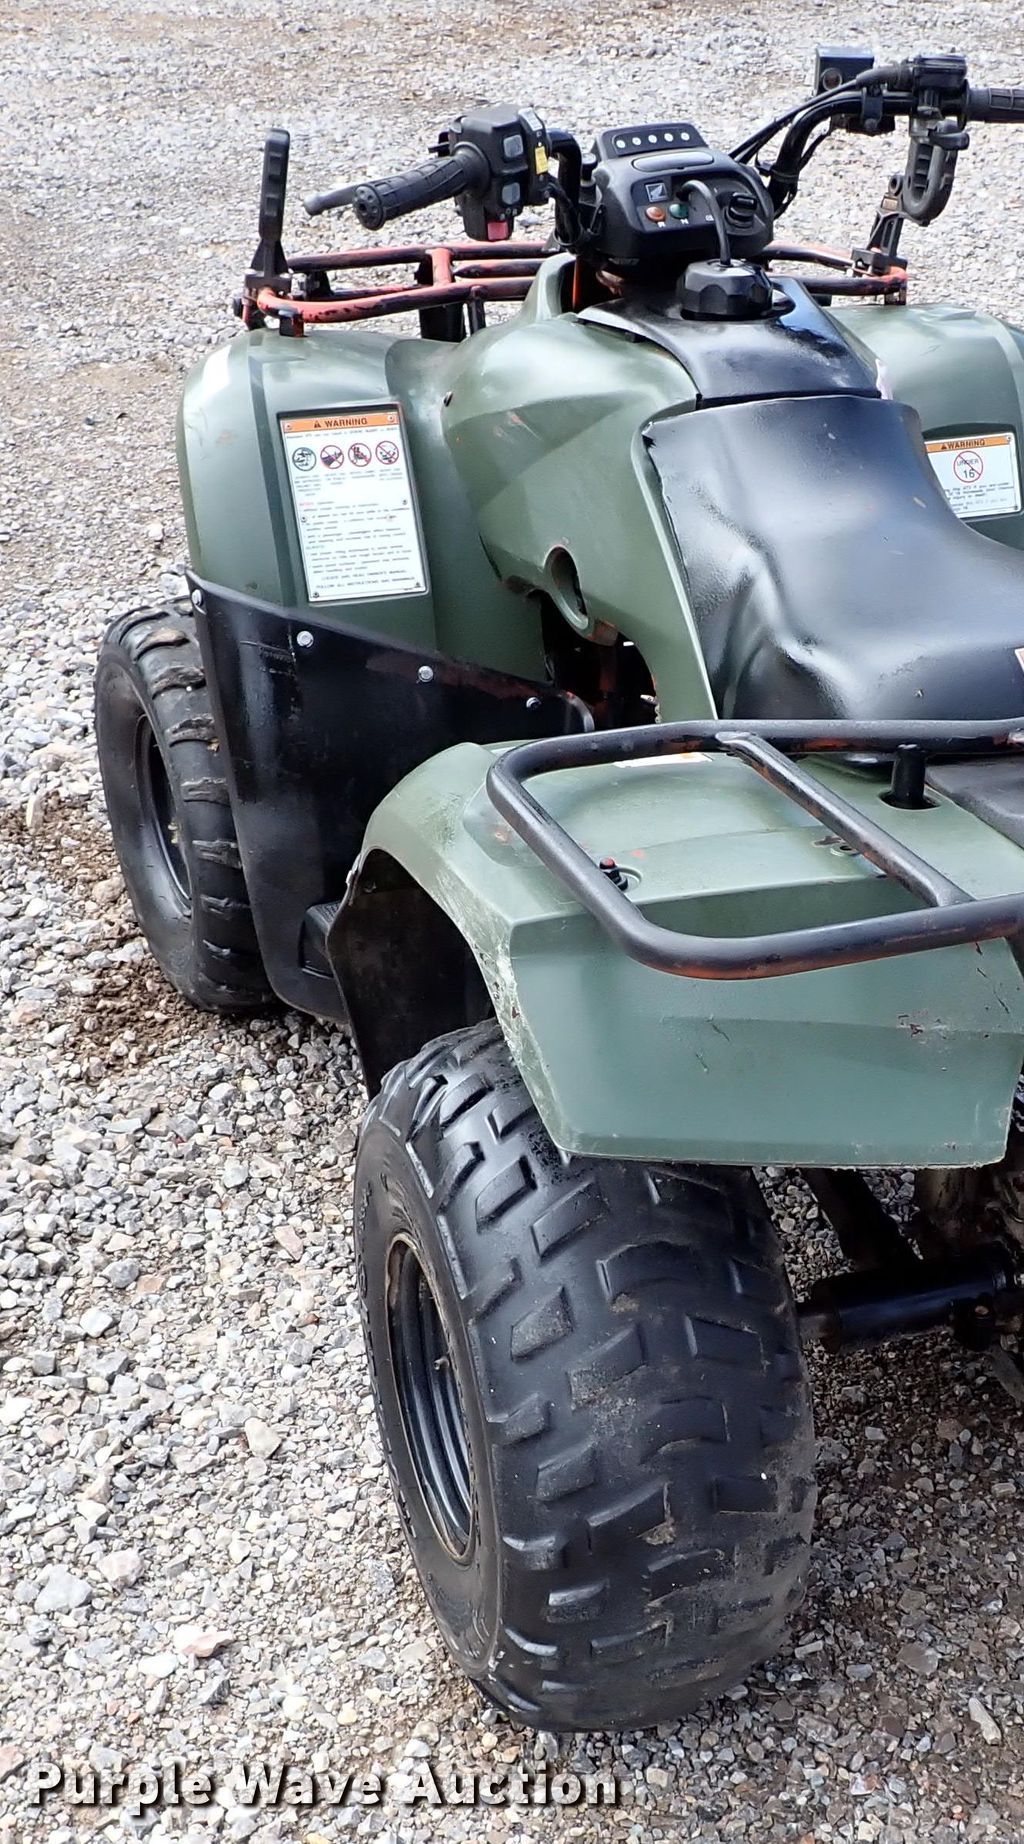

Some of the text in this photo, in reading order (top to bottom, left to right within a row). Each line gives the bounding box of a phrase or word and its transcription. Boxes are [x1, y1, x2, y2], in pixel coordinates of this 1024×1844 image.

[324, 417, 368, 428] WARNING
[948, 439, 985, 449] WARNING
[957, 458, 979, 466] UNDER
[964, 470, 975, 479] 16
